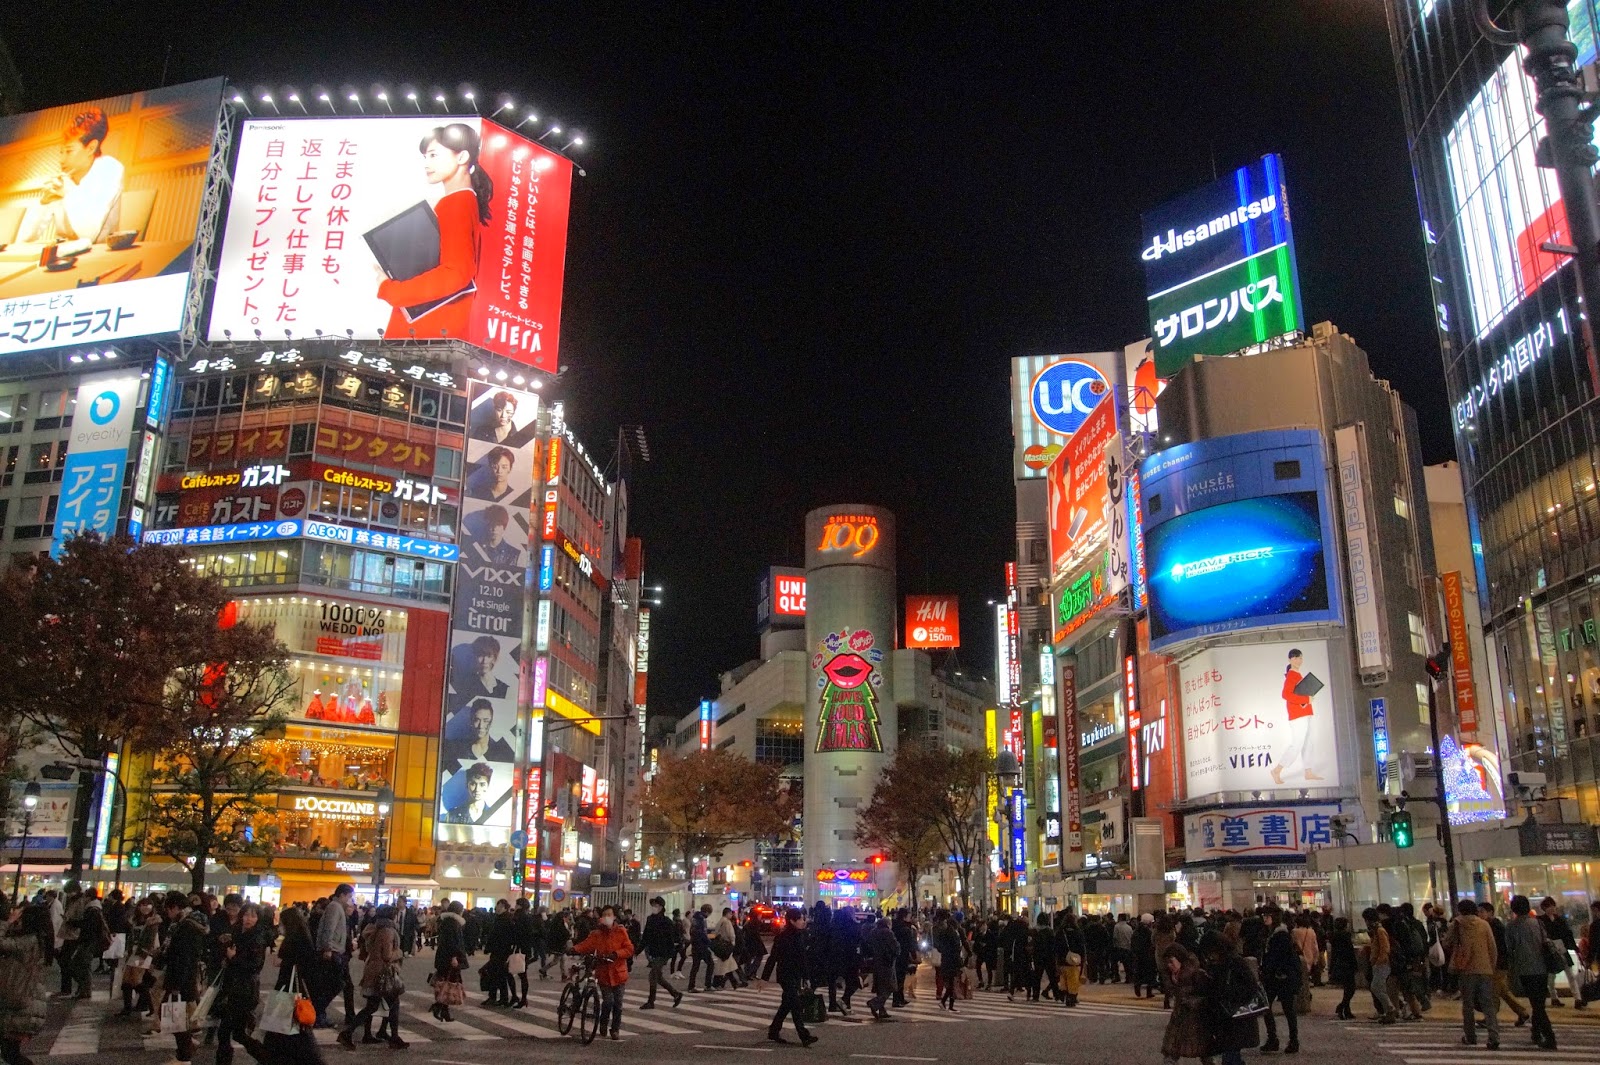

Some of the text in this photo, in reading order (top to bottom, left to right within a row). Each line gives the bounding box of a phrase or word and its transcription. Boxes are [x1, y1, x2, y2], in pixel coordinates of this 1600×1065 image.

[321, 138, 357, 286] たまの休日も、
[243, 138, 285, 326] 自分にプレゼント。
[275, 138, 323, 323] 返上して仕事した
[1141, 195, 1277, 261] Hisamitsu
[0, 294, 74, 318] 材サービス
[1153, 274, 1284, 348] サロンパス
[487, 316, 541, 354] VIERA
[77, 426, 123, 444] eyecity
[317, 427, 431, 467] コンタクト
[242, 464, 291, 488] ガスト
[393, 477, 447, 506] ガスト
[59, 466, 96, 549] アイシ
[157, 505, 179, 523] 7F
[211, 496, 271, 525] ガスト
[829, 516, 878, 524] SHIBUYA
[186, 525, 274, 544] 英会話イーオン
[308, 523, 348, 541] AEON
[355, 531, 455, 558] 英会話イーオン
[818, 523, 879, 557] 109
[461, 562, 521, 587] VIXX
[480, 584, 504, 598] 12.10
[779, 580, 806, 597] UNI
[321, 603, 385, 627] 1000%
[472, 597, 510, 613] 1st Single
[917, 600, 948, 622] H&M
[928, 633, 953, 642] 150m
[1445, 576, 1475, 724] クスリのことなら 三千里
[1184, 668, 1223, 694] 恋も仕事も
[1186, 693, 1222, 717] がんばった
[1081, 722, 1115, 748] Euphoria
[1187, 714, 1274, 742] 自分にプレゼント。
[1229, 752, 1273, 769] VIERA
[295, 796, 375, 815] L'OCCITANE
